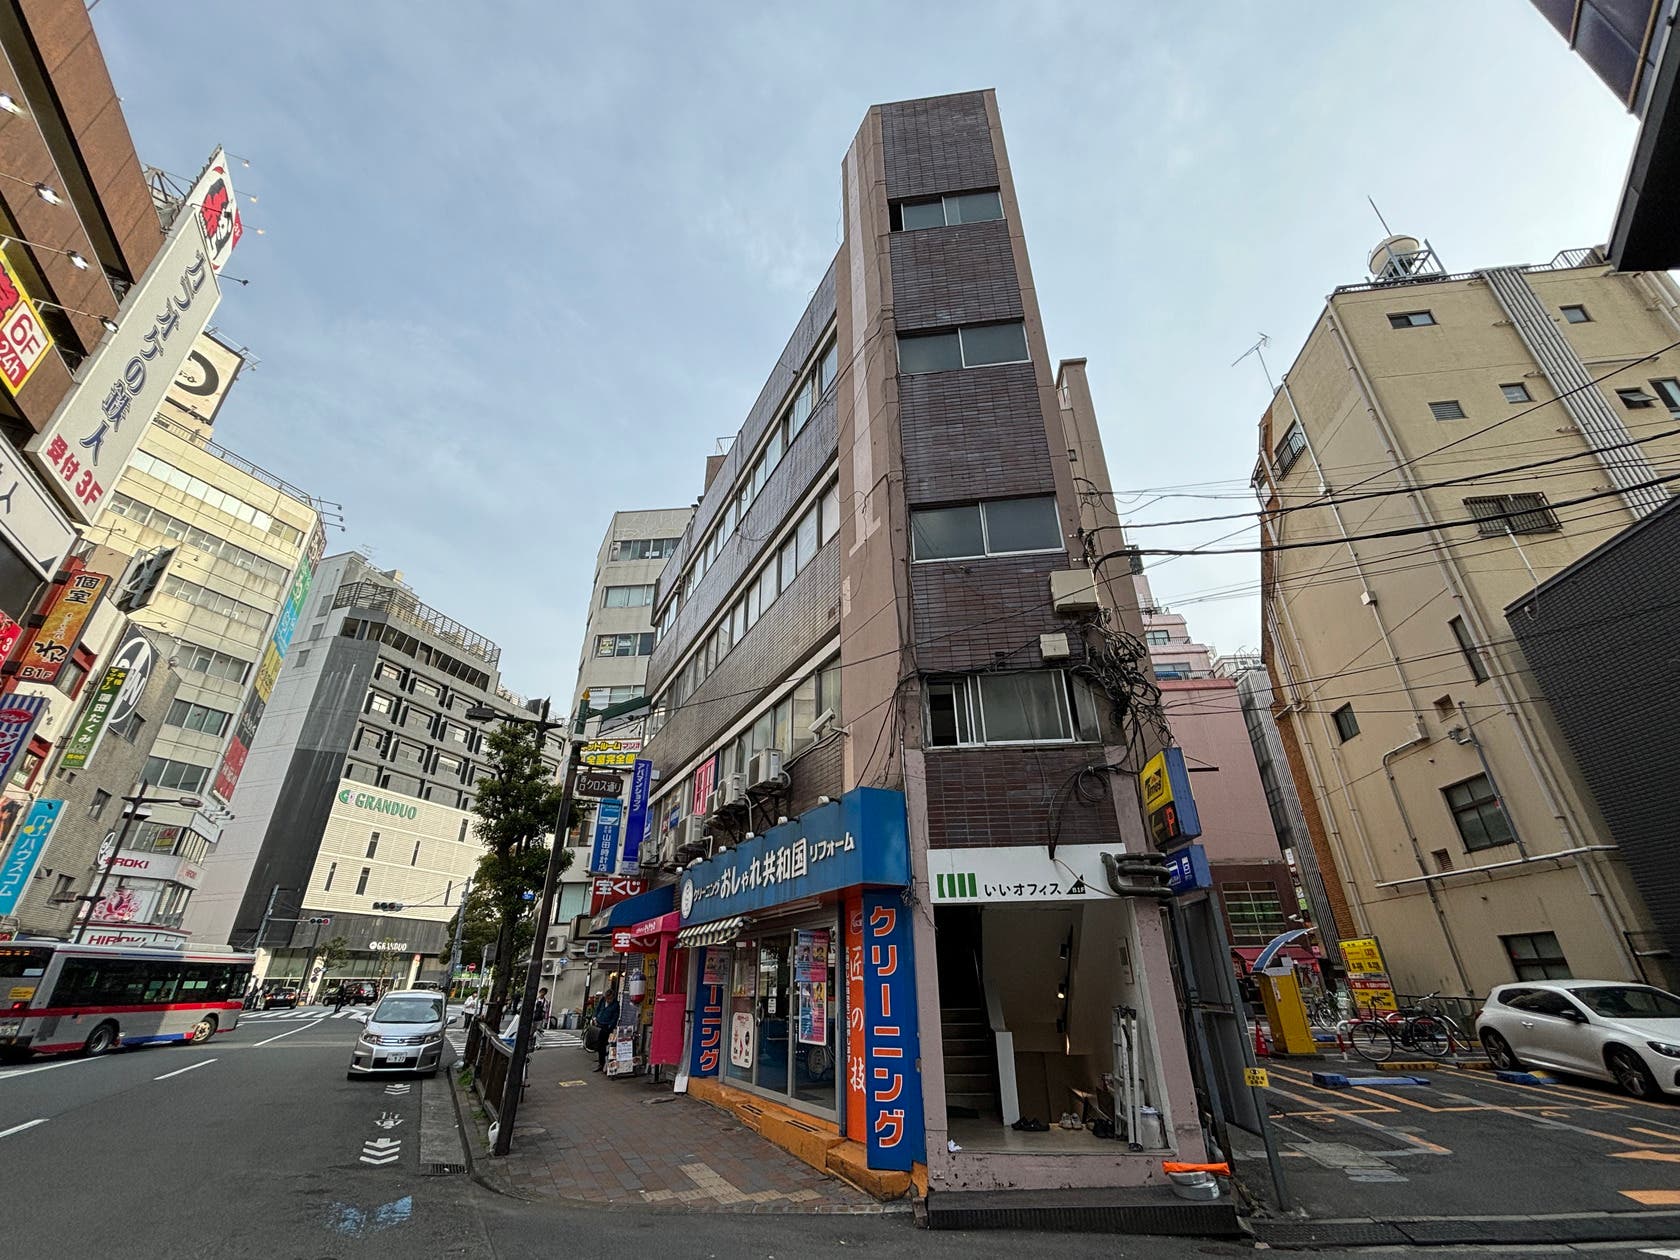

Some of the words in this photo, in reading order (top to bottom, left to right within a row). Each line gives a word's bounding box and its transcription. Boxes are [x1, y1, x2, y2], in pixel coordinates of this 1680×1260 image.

[10, 313, 41, 355] 6F
[80, 250, 207, 467] カラオケの鉄人
[46, 433, 80, 482] 受付
[75, 469, 104, 506] 3F
[65, 574, 100, 604] 個室
[22, 667, 54, 680] B1F
[355, 793, 418, 820] GRANDUO
[0, 839, 36, 897] ハウスコム
[595, 879, 641, 896] 宝くじ
[693, 879, 720, 902] クリーニング
[720, 837, 808, 899] おしゃれ共和国
[809, 831, 856, 863] リフォーム
[984, 883, 1062, 897] いいオフィス
[700, 984, 721, 1071] ーニング
[850, 945, 868, 1095] 匠の技
[869, 905, 905, 1148] クリーニング
